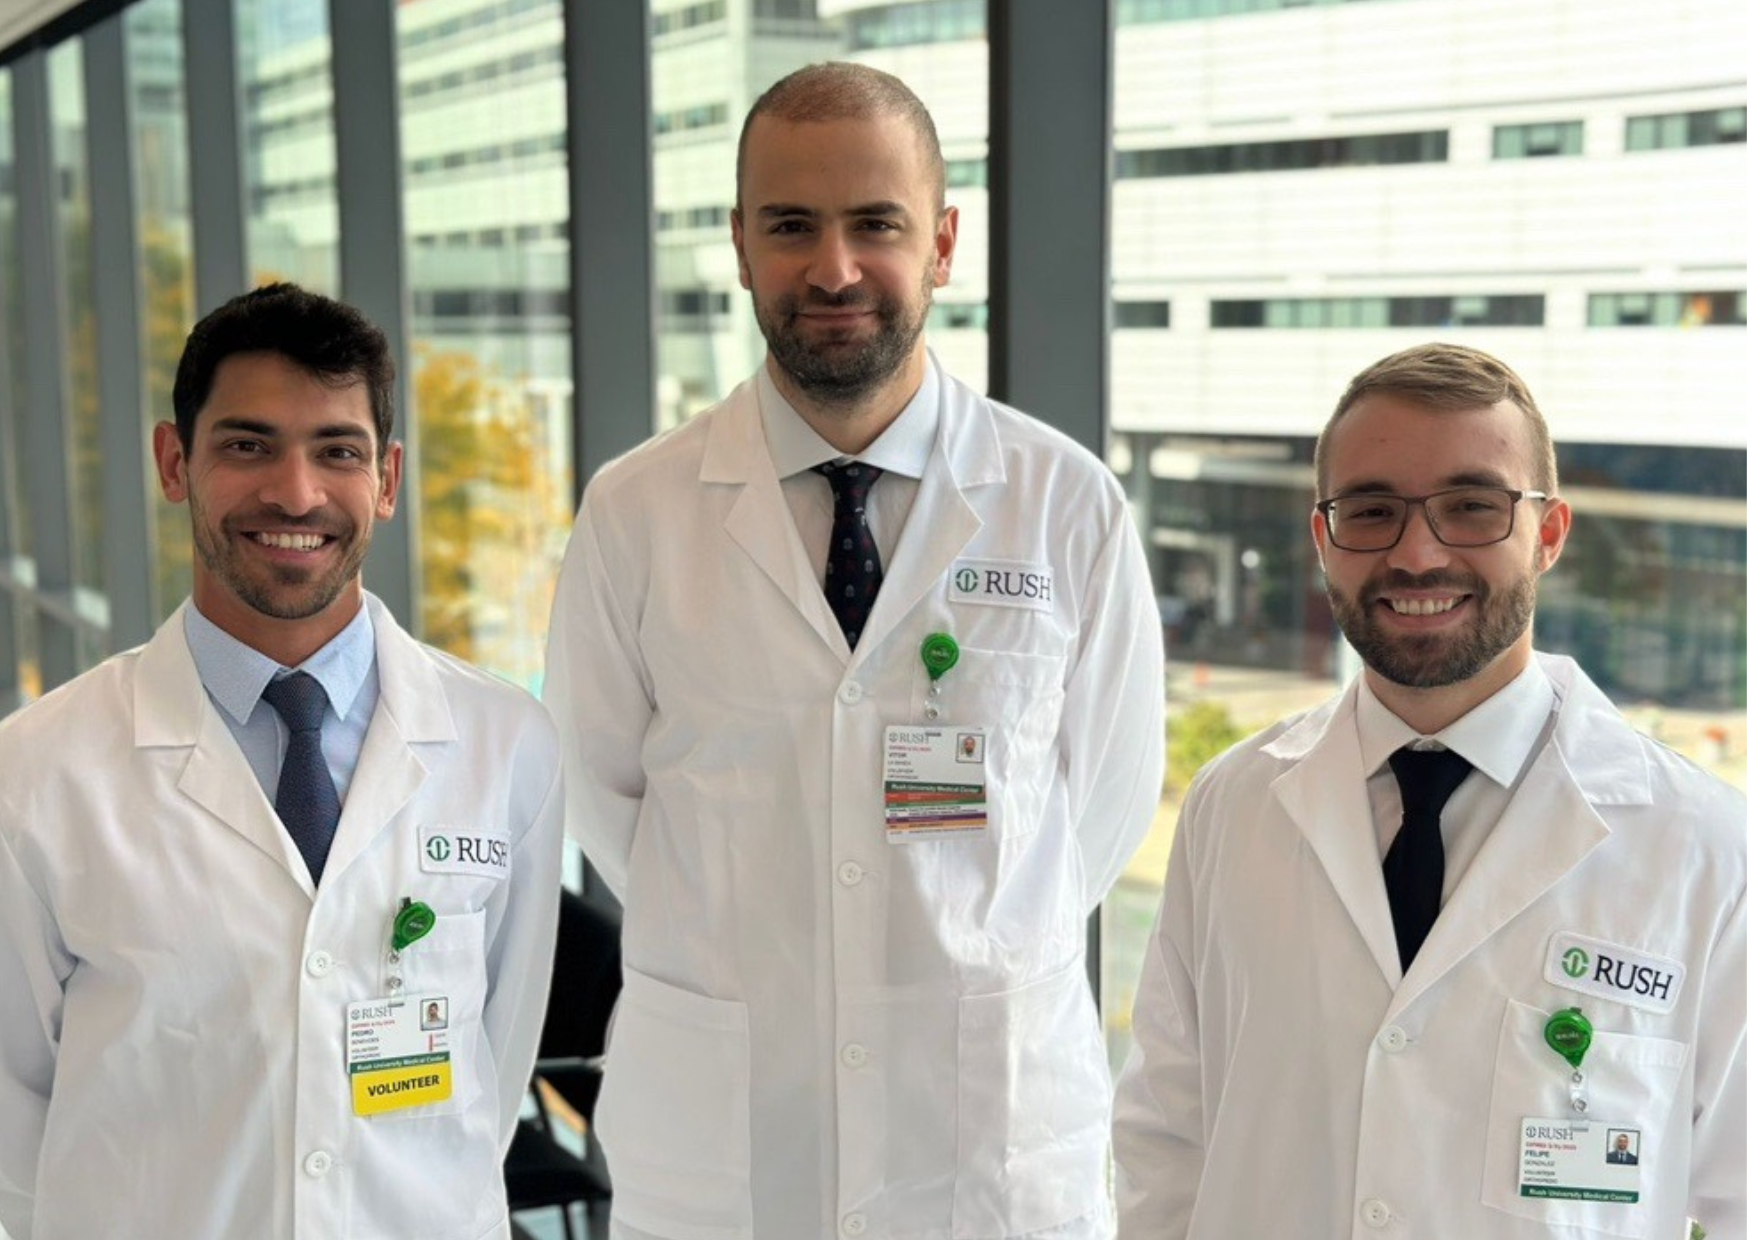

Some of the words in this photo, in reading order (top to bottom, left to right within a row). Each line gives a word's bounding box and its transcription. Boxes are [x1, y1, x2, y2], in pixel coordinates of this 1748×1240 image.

[984, 570, 1051, 601] RUSH
[900, 732, 930, 744] RUSH
[907, 785, 937, 793] University
[455, 836, 507, 867] RUSH
[1593, 954, 1673, 1000] RUSH
[362, 1006, 393, 1019] RUSH
[373, 1060, 402, 1069] University
[403, 1057, 426, 1065] Medical
[368, 1074, 440, 1097] VOLUNTEER
[1538, 1127, 1574, 1140] RUSH
[1525, 1150, 1550, 1158] FELIPE
[1529, 1188, 1547, 1196] Rush
[1548, 1189, 1582, 1199] University
[1583, 1191, 1609, 1199] Medical
[1610, 1193, 1633, 1201] Center
